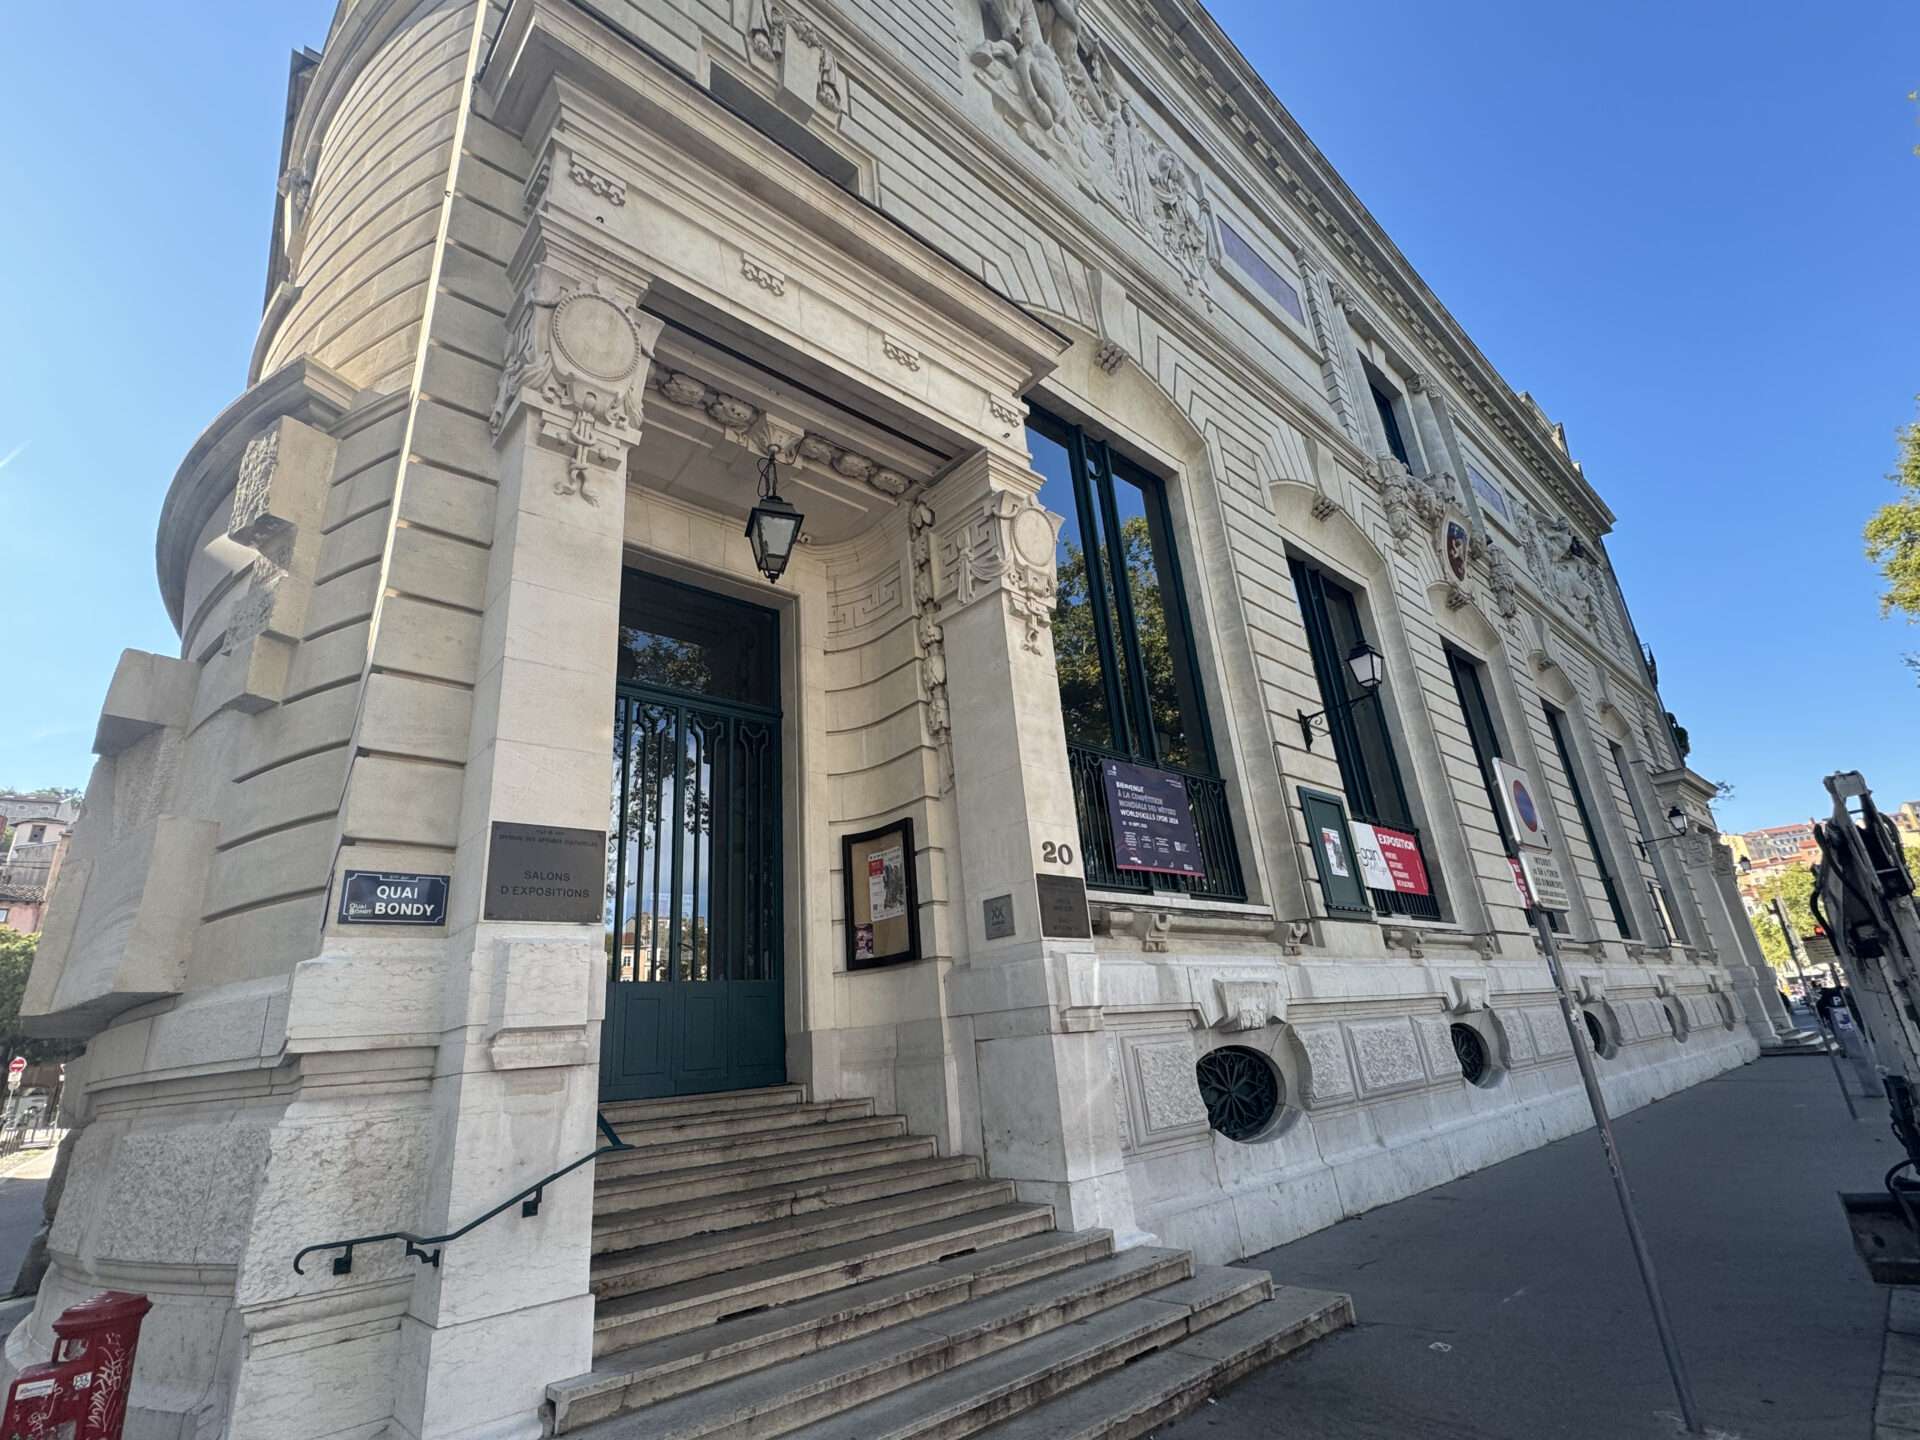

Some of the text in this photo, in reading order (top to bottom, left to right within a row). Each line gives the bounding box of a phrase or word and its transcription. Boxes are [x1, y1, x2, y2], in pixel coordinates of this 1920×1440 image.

[1122, 791, 1130, 799] LA
[1377, 833, 1415, 851] EXPOSITION
[1042, 841, 1073, 865] 20
[524, 870, 571, 882] SALONS
[376, 885, 418, 899] QUAI
[500, 885, 590, 898] D'EXPOSITIONS
[374, 902, 435, 916] BONDY
